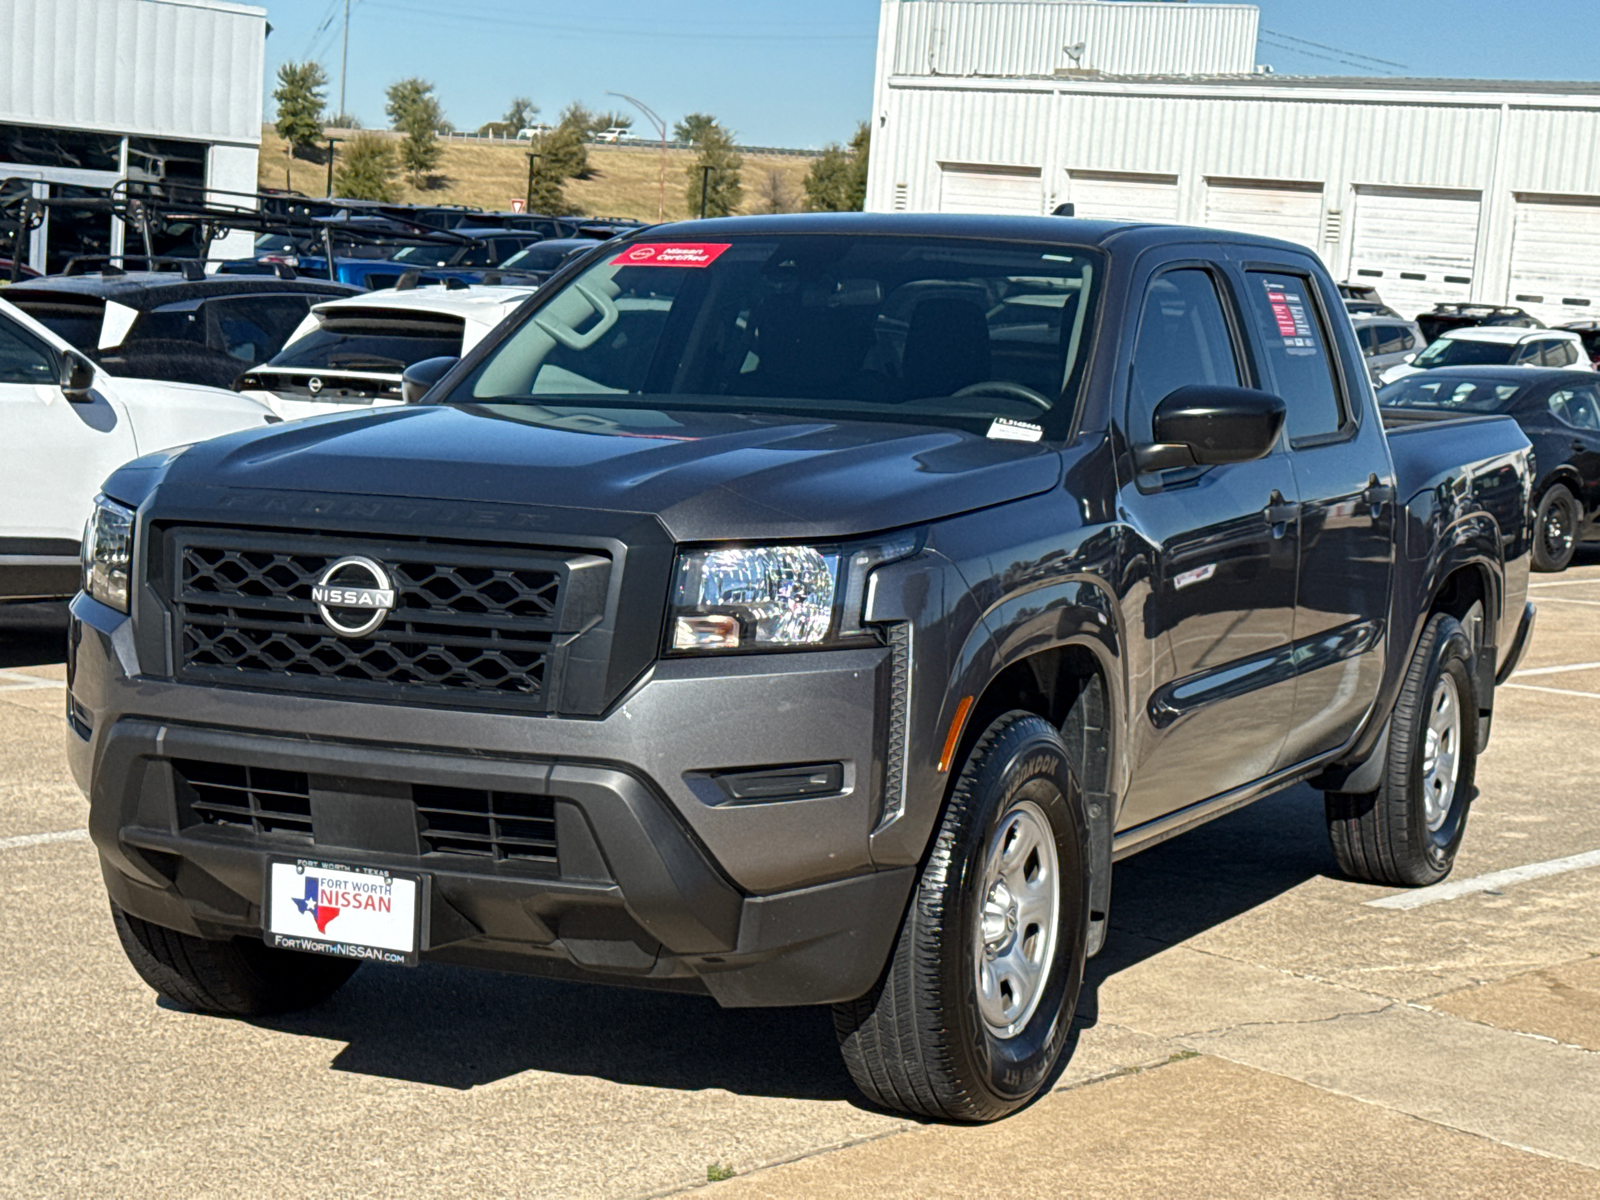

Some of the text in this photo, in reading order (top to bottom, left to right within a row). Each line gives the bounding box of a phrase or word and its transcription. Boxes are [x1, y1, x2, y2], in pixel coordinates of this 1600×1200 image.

[656, 254, 709, 262] Certified
[217, 492, 551, 527] FRONTIER
[312, 587, 390, 606] NISSAN
[297, 859, 390, 878] FORT WORTH TEXAS
[320, 878, 392, 896] FORT WORTH
[320, 889, 391, 913] NISSAN
